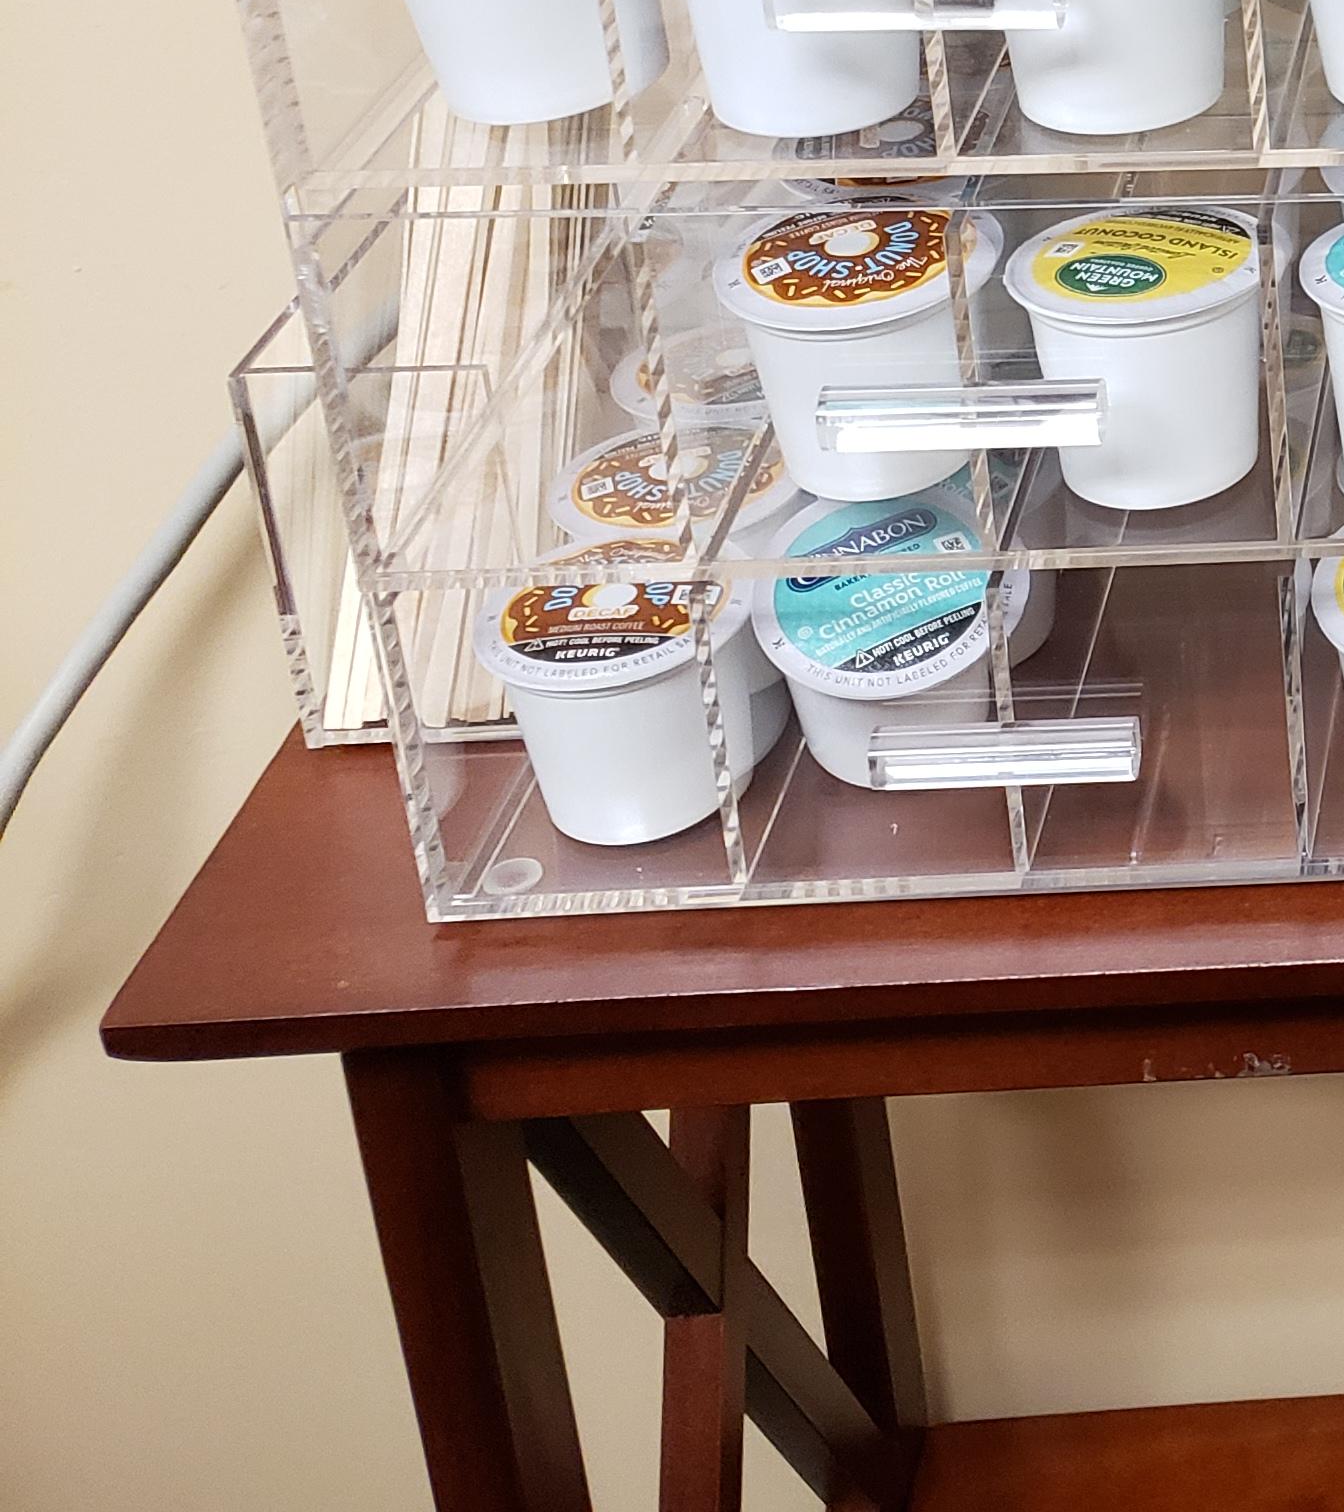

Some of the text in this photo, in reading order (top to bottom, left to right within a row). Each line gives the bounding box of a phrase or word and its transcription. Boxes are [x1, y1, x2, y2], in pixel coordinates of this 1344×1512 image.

[785, 221, 920, 278] DONUT SHOP
[1072, 227, 1239, 260] ISLAND COCONUT
[822, 255, 929, 292] The Original
[1069, 262, 1158, 283] MOUNTAIN
[1075, 271, 1136, 288] GREEN
[615, 471, 667, 502] SHOP
[850, 572, 920, 608] Classic
[612, 621, 645, 630] COFFEE
[818, 588, 922, 640] Cinnamon
[568, 637, 590, 646] COOL
[624, 635, 659, 645] PEELING
[871, 608, 976, 658] HOT! COOL BEFORE PEELING
[892, 632, 950, 666] KEURIG
[520, 647, 675, 678] NOT LABELED FOR RETAIL
[554, 647, 620, 659] KEURIG
[806, 616, 988, 688] THIS UNIT NOT LABELED FOR RETA
